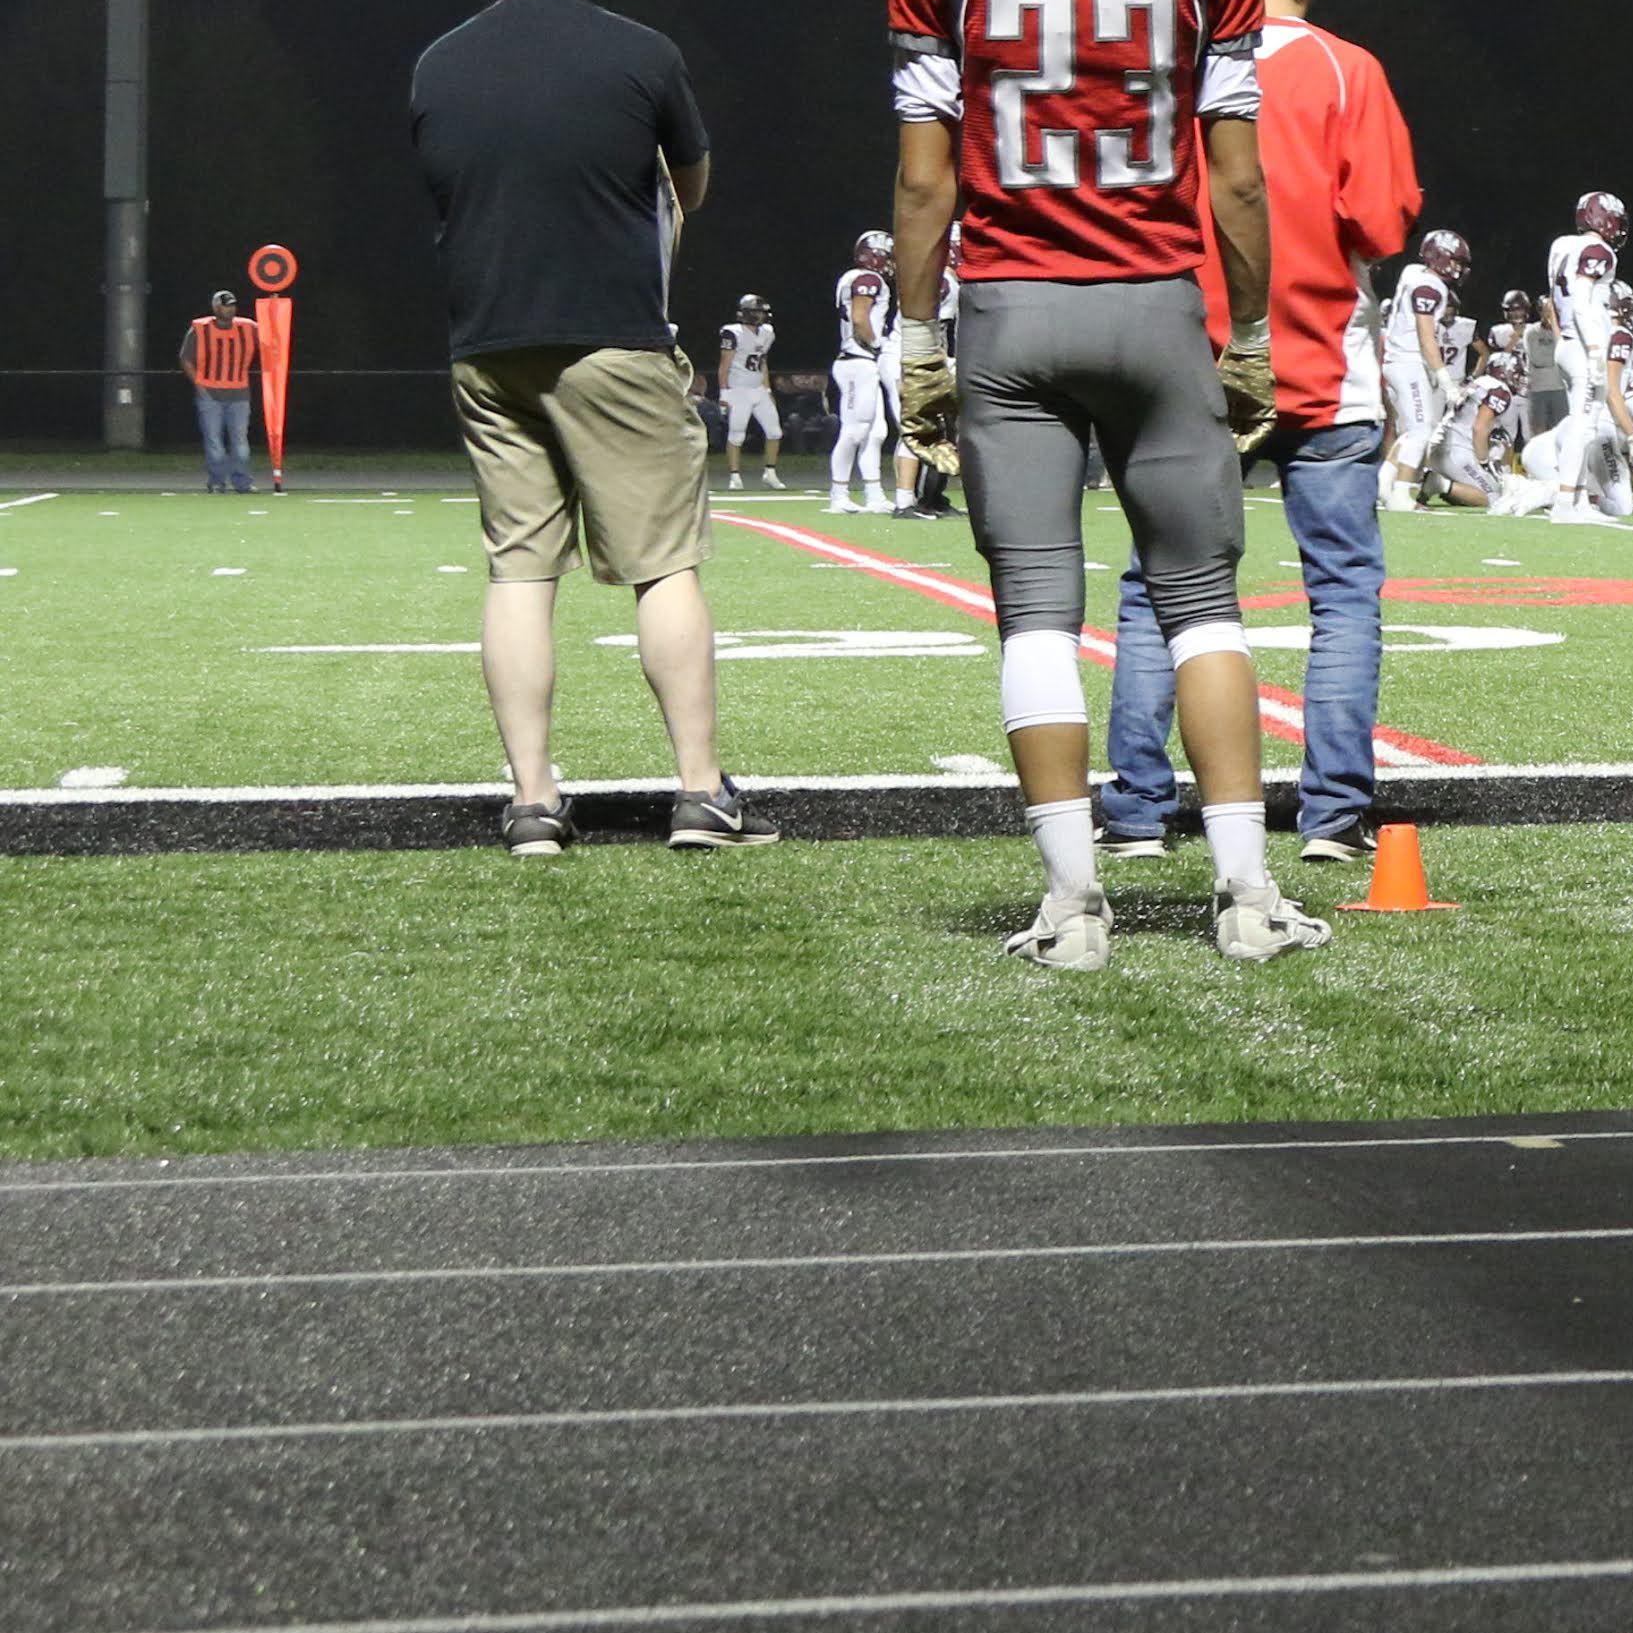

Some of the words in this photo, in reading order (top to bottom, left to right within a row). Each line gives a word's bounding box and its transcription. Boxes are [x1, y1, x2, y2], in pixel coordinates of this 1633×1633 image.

[1416, 296, 1437, 313] 57
[1408, 381, 1424, 424] WOLFPACK
[1488, 394, 1508, 414] 55
[1601, 441, 1621, 484] WOLFPACK
[1463, 464, 1494, 495] WOLFPACK
